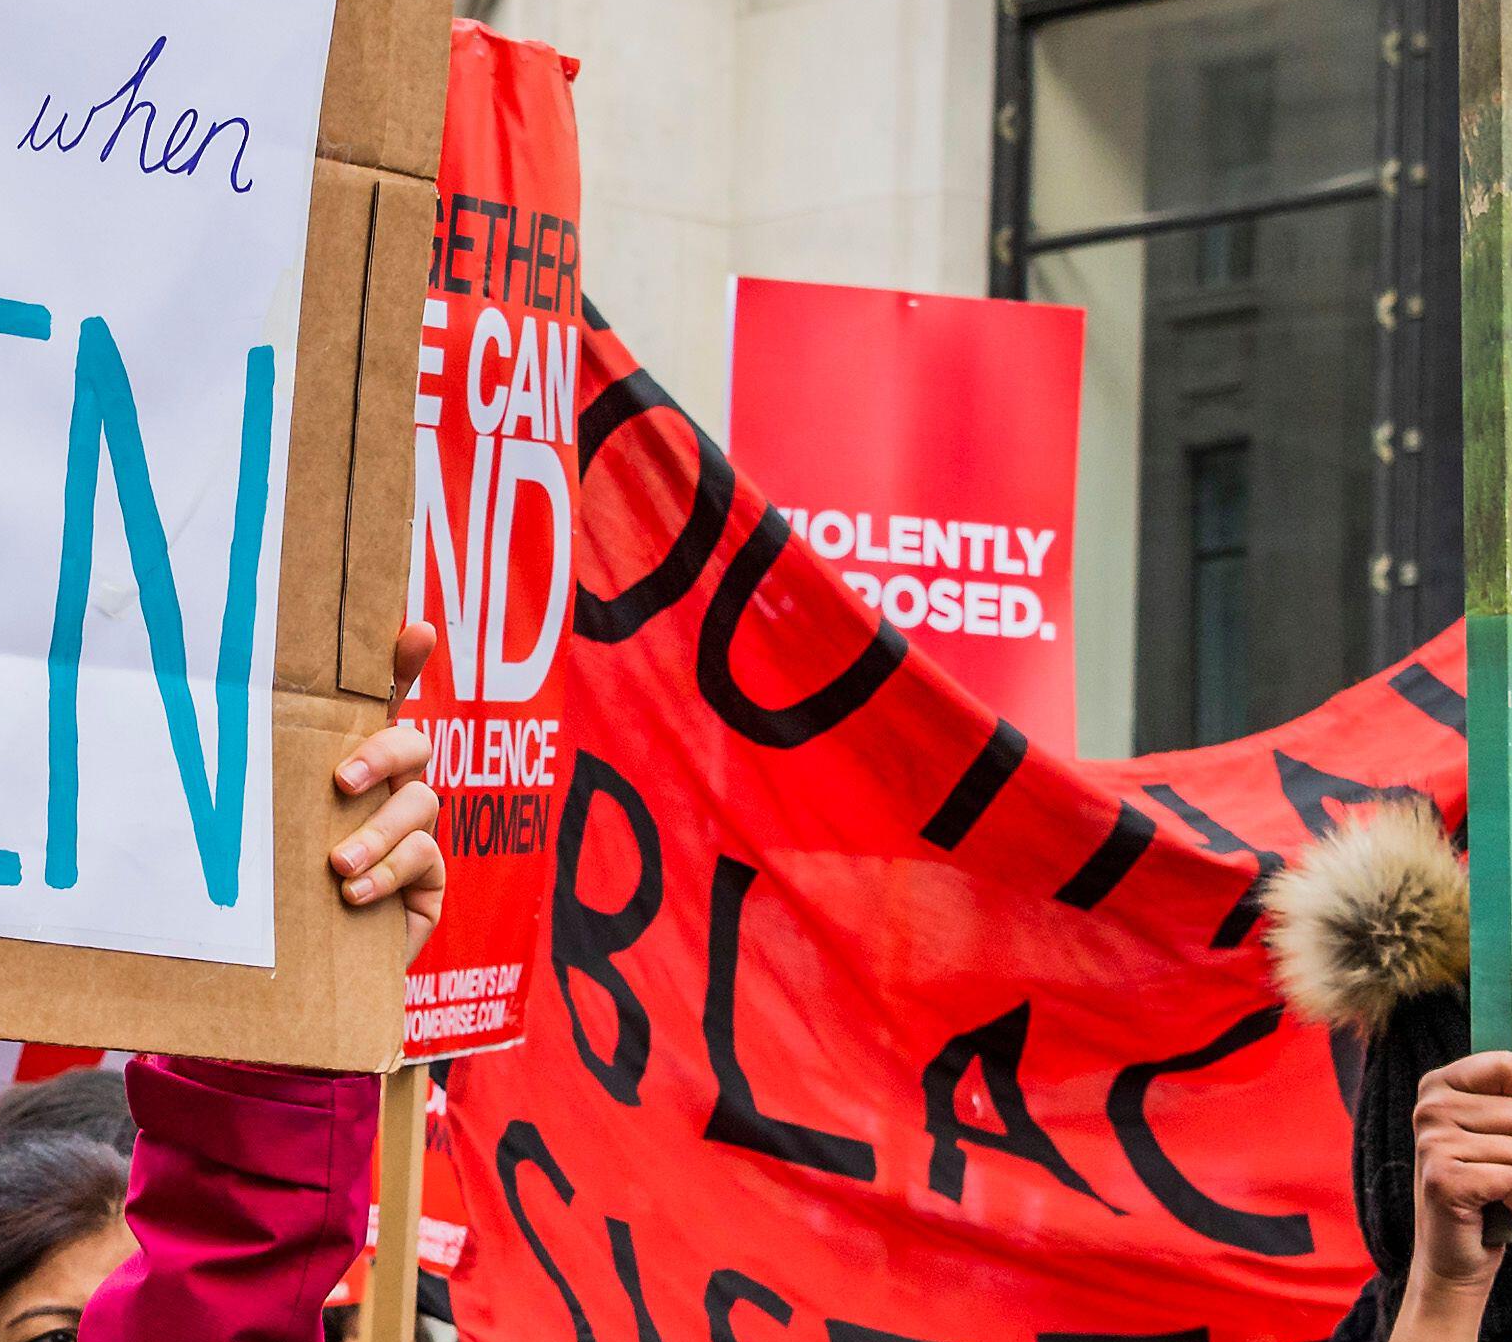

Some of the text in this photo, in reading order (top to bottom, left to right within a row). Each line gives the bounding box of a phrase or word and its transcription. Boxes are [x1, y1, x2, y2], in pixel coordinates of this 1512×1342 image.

[18, 35, 254, 193] when
[466, 306, 577, 446] CAN
[422, 719, 560, 789] VIOLENCE
[450, 793, 551, 858] WOMEN
